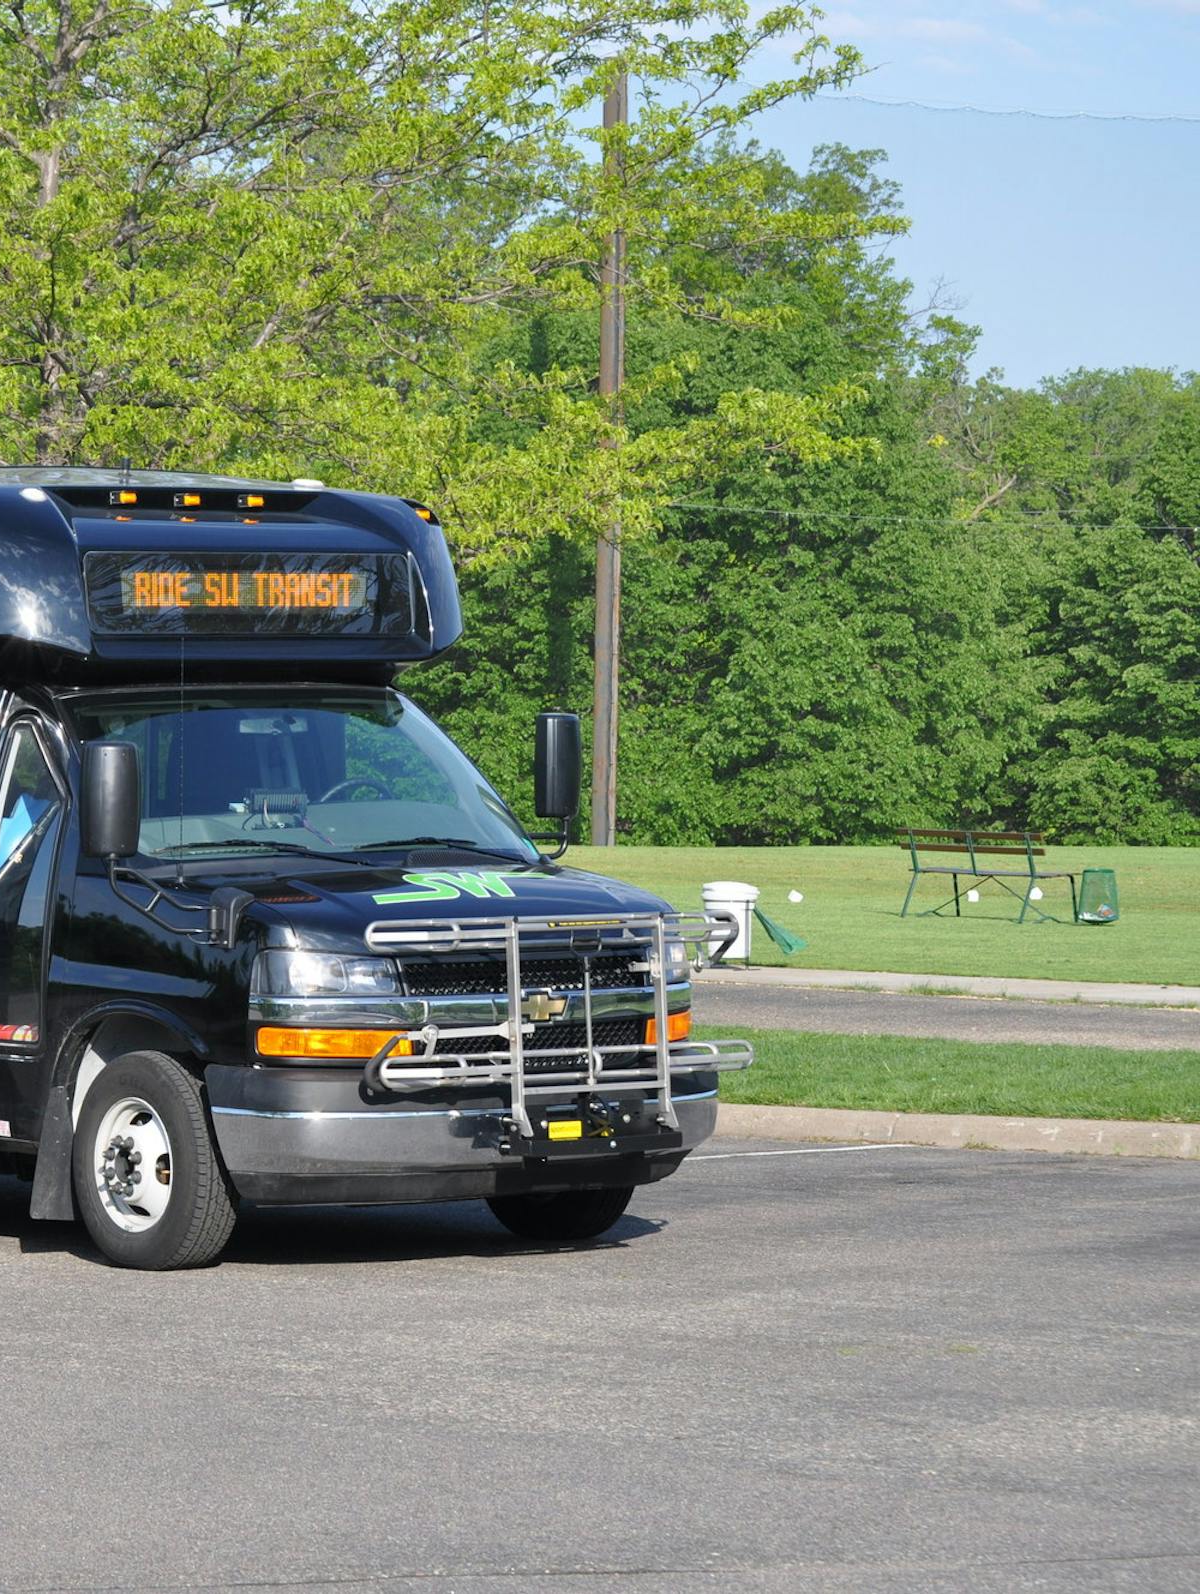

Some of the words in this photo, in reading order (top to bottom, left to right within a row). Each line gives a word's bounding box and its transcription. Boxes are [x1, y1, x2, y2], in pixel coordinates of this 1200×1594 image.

[134, 571, 192, 608] RIDE
[205, 572, 240, 607] SW
[253, 572, 353, 608] TRANSIT
[373, 872, 518, 904] SW
